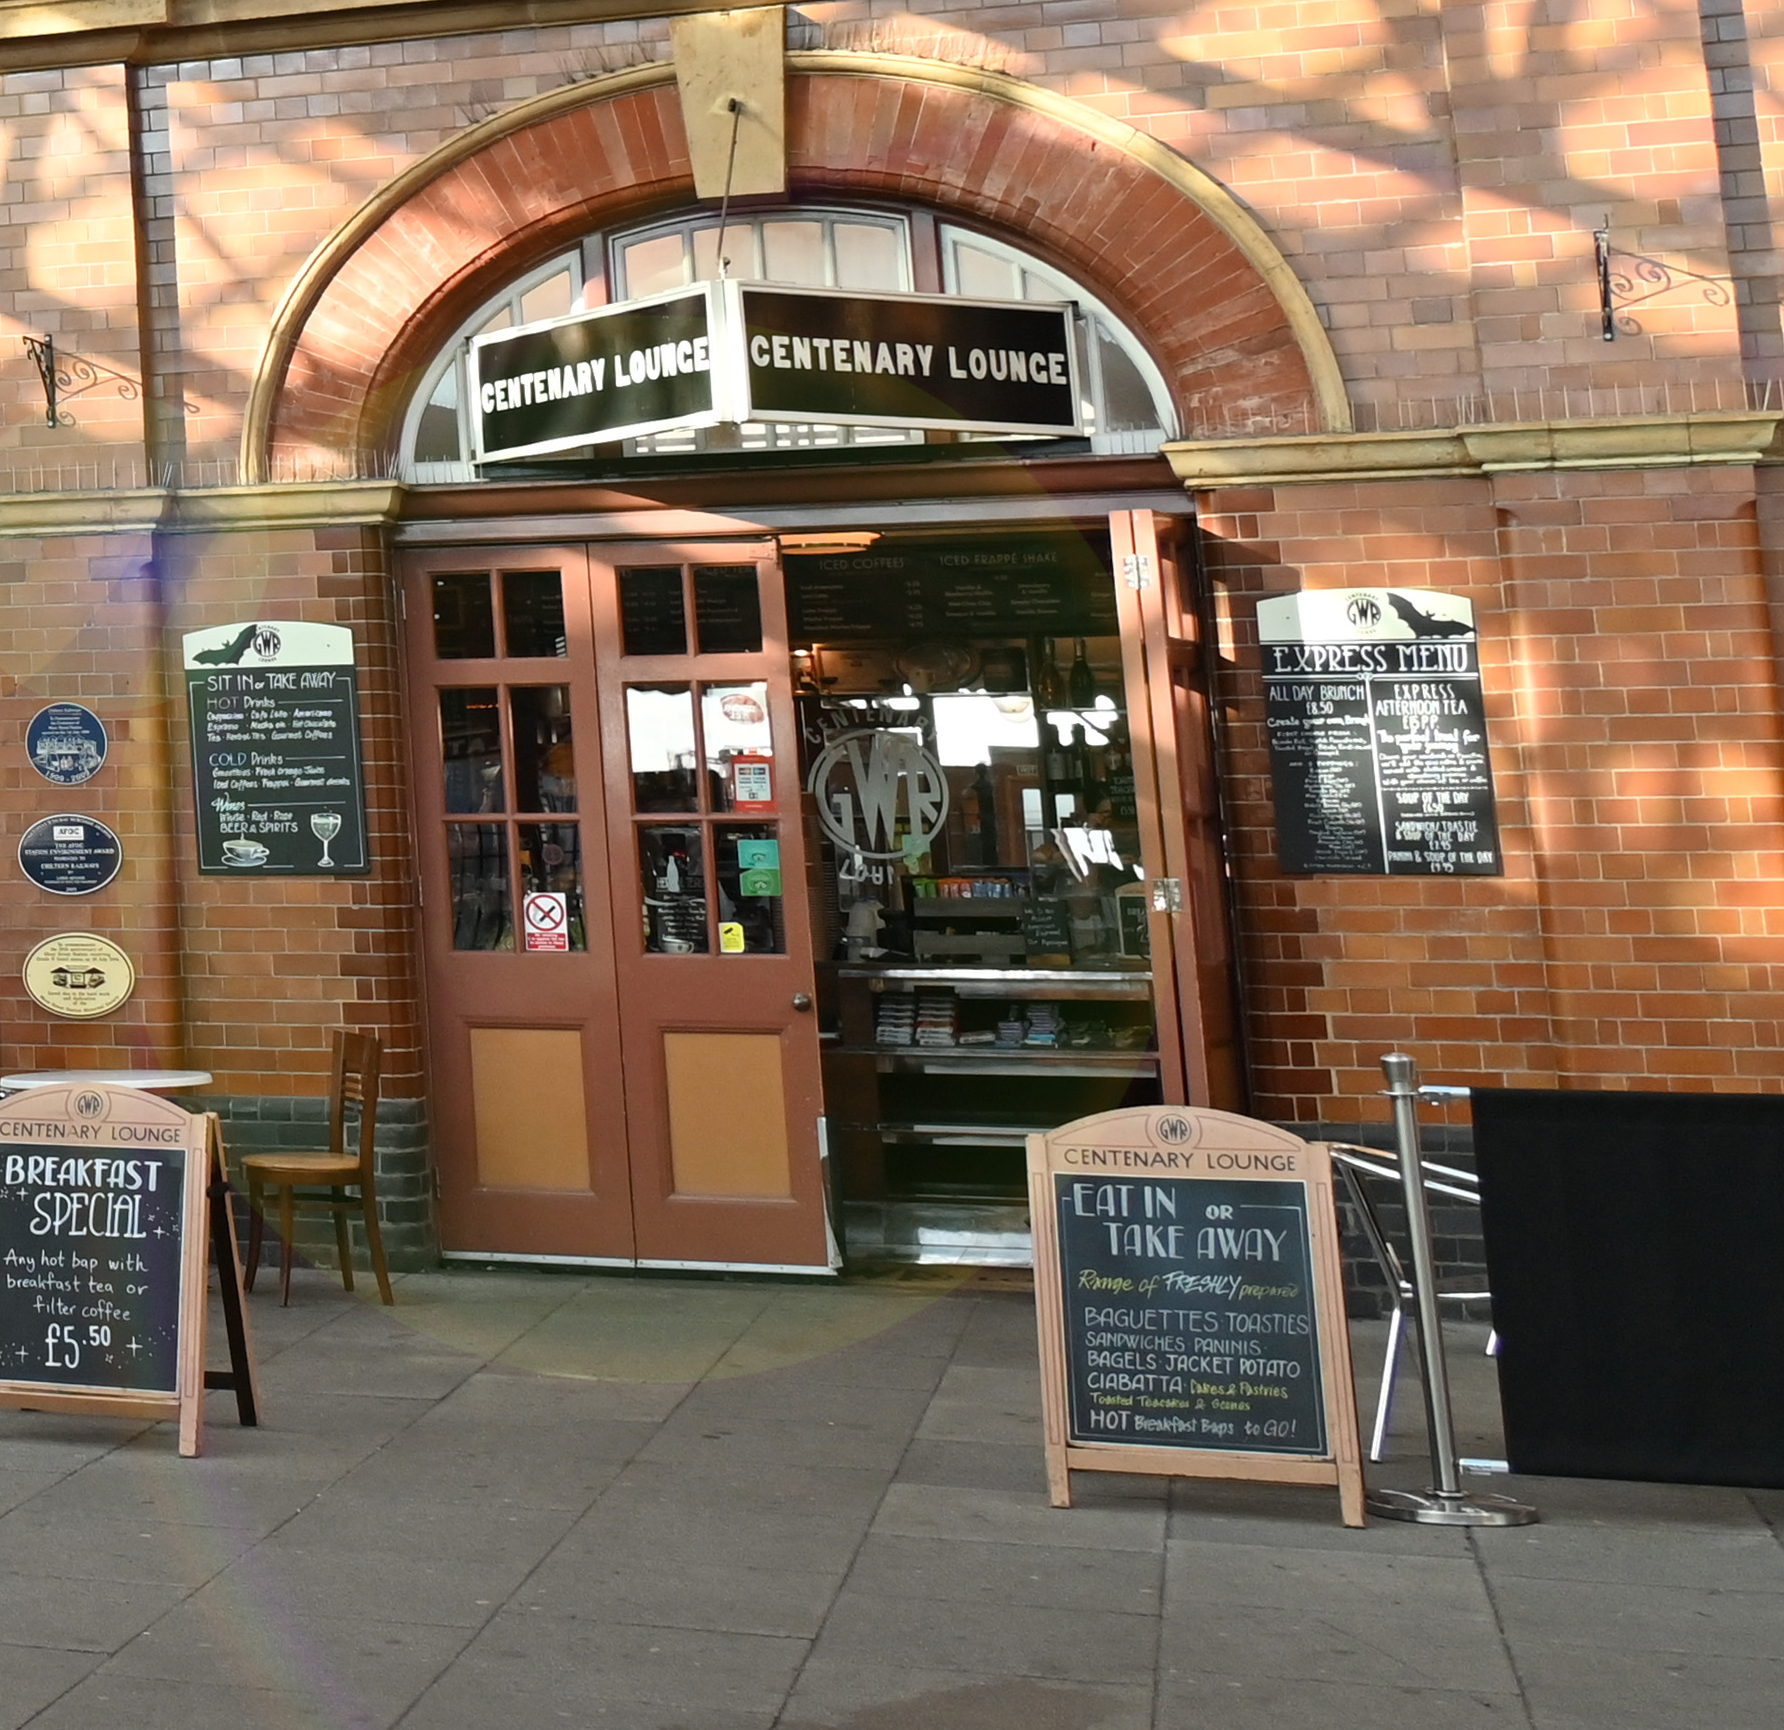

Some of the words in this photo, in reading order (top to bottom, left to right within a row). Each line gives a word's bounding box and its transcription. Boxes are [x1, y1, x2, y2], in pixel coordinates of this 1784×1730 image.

[750, 334, 934, 379] CENTENARY
[948, 346, 1068, 387] LOUNGE
[480, 358, 606, 415] CENTENARY
[614, 336, 711, 390] LOUNGE
[852, 557, 905, 570] COFFEES
[940, 554, 969, 567] ICED
[1347, 598, 1381, 629] GWR
[254, 631, 280, 657] GWR
[1273, 644, 1388, 673] EXPRESS
[1396, 644, 1468, 672] MENU
[207, 675, 232, 692] SIT
[237, 675, 254, 691] IN
[265, 672, 298, 689] TAKE
[301, 672, 337, 689] AWAY
[1269, 685, 1289, 701] ALL
[1292, 685, 1315, 701] DAY
[1320, 684, 1365, 701] BRUNCH
[1394, 684, 1455, 700] EXPRESS
[207, 697, 239, 710] HOT
[243, 696, 276, 709] Drinks
[1375, 699, 1440, 717] AFTERNOON
[1442, 700, 1468, 715] TEA
[209, 752, 247, 766] COLD
[251, 752, 283, 765] Drinks
[816, 733, 941, 851] GWR
[1396, 791, 1420, 804] SOUP
[1453, 792, 1469, 804] DAY
[220, 822, 249, 834] BEER
[259, 822, 299, 833] SPIRITS
[1457, 831, 1475, 842] DAY
[1424, 852, 1446, 863] SOUP
[1476, 851, 1493, 864] DAY
[77, 1093, 102, 1115] GWR
[0, 1123, 102, 1141] CENTENARY
[111, 1125, 181, 1143] LOUNGE
[1160, 1118, 1187, 1140] GWR
[1064, 1149, 1194, 1168] CENTENARY
[1208, 1153, 1296, 1171] LOUNGE
[5, 1155, 163, 1192] BREAKFAST
[1073, 1183, 1134, 1217] EAT
[1143, 1186, 1176, 1219] IN
[1205, 1204, 1233, 1220] OR
[29, 1191, 147, 1239] SPECIAL
[1103, 1222, 1185, 1259] TAKE
[1197, 1226, 1287, 1262] AWAY
[3, 1248, 35, 1272] Any
[41, 1249, 65, 1268] hot
[71, 1250, 98, 1277] bap
[108, 1253, 148, 1273] with
[6, 1272, 81, 1294] breakfast
[88, 1276, 114, 1294] tea
[126, 1282, 148, 1296] or
[1079, 1269, 1134, 1294] Range
[1138, 1275, 1159, 1298] of
[1162, 1271, 1242, 1299] FRESHLY
[1238, 1284, 1299, 1299] prepared
[33, 1296, 76, 1315] filter
[82, 1297, 132, 1322] coffee
[1084, 1307, 1219, 1332] BAGUETTES
[1224, 1312, 1309, 1334] TOASTIES
[45, 1323, 111, 1369] £5.50
[1085, 1331, 1185, 1352] SANDWICHES
[1194, 1337, 1262, 1356] PANINIS
[1088, 1351, 1157, 1369] BAGELS
[1165, 1354, 1233, 1374] JACKET
[1240, 1358, 1301, 1378] POTATO
[1087, 1371, 1182, 1393] CIABATTA
[1190, 1379, 1223, 1395] Cakes
[1239, 1381, 1288, 1398] Pastries
[1090, 1392, 1133, 1406] Toasted
[1136, 1395, 1190, 1408] Teacakes
[1090, 1410, 1131, 1431] HOT
[1134, 1415, 1197, 1433] Breakfast
[1201, 1419, 1234, 1436] Baps
[1244, 1420, 1261, 1436] to
[1263, 1419, 1297, 1438] GO!
